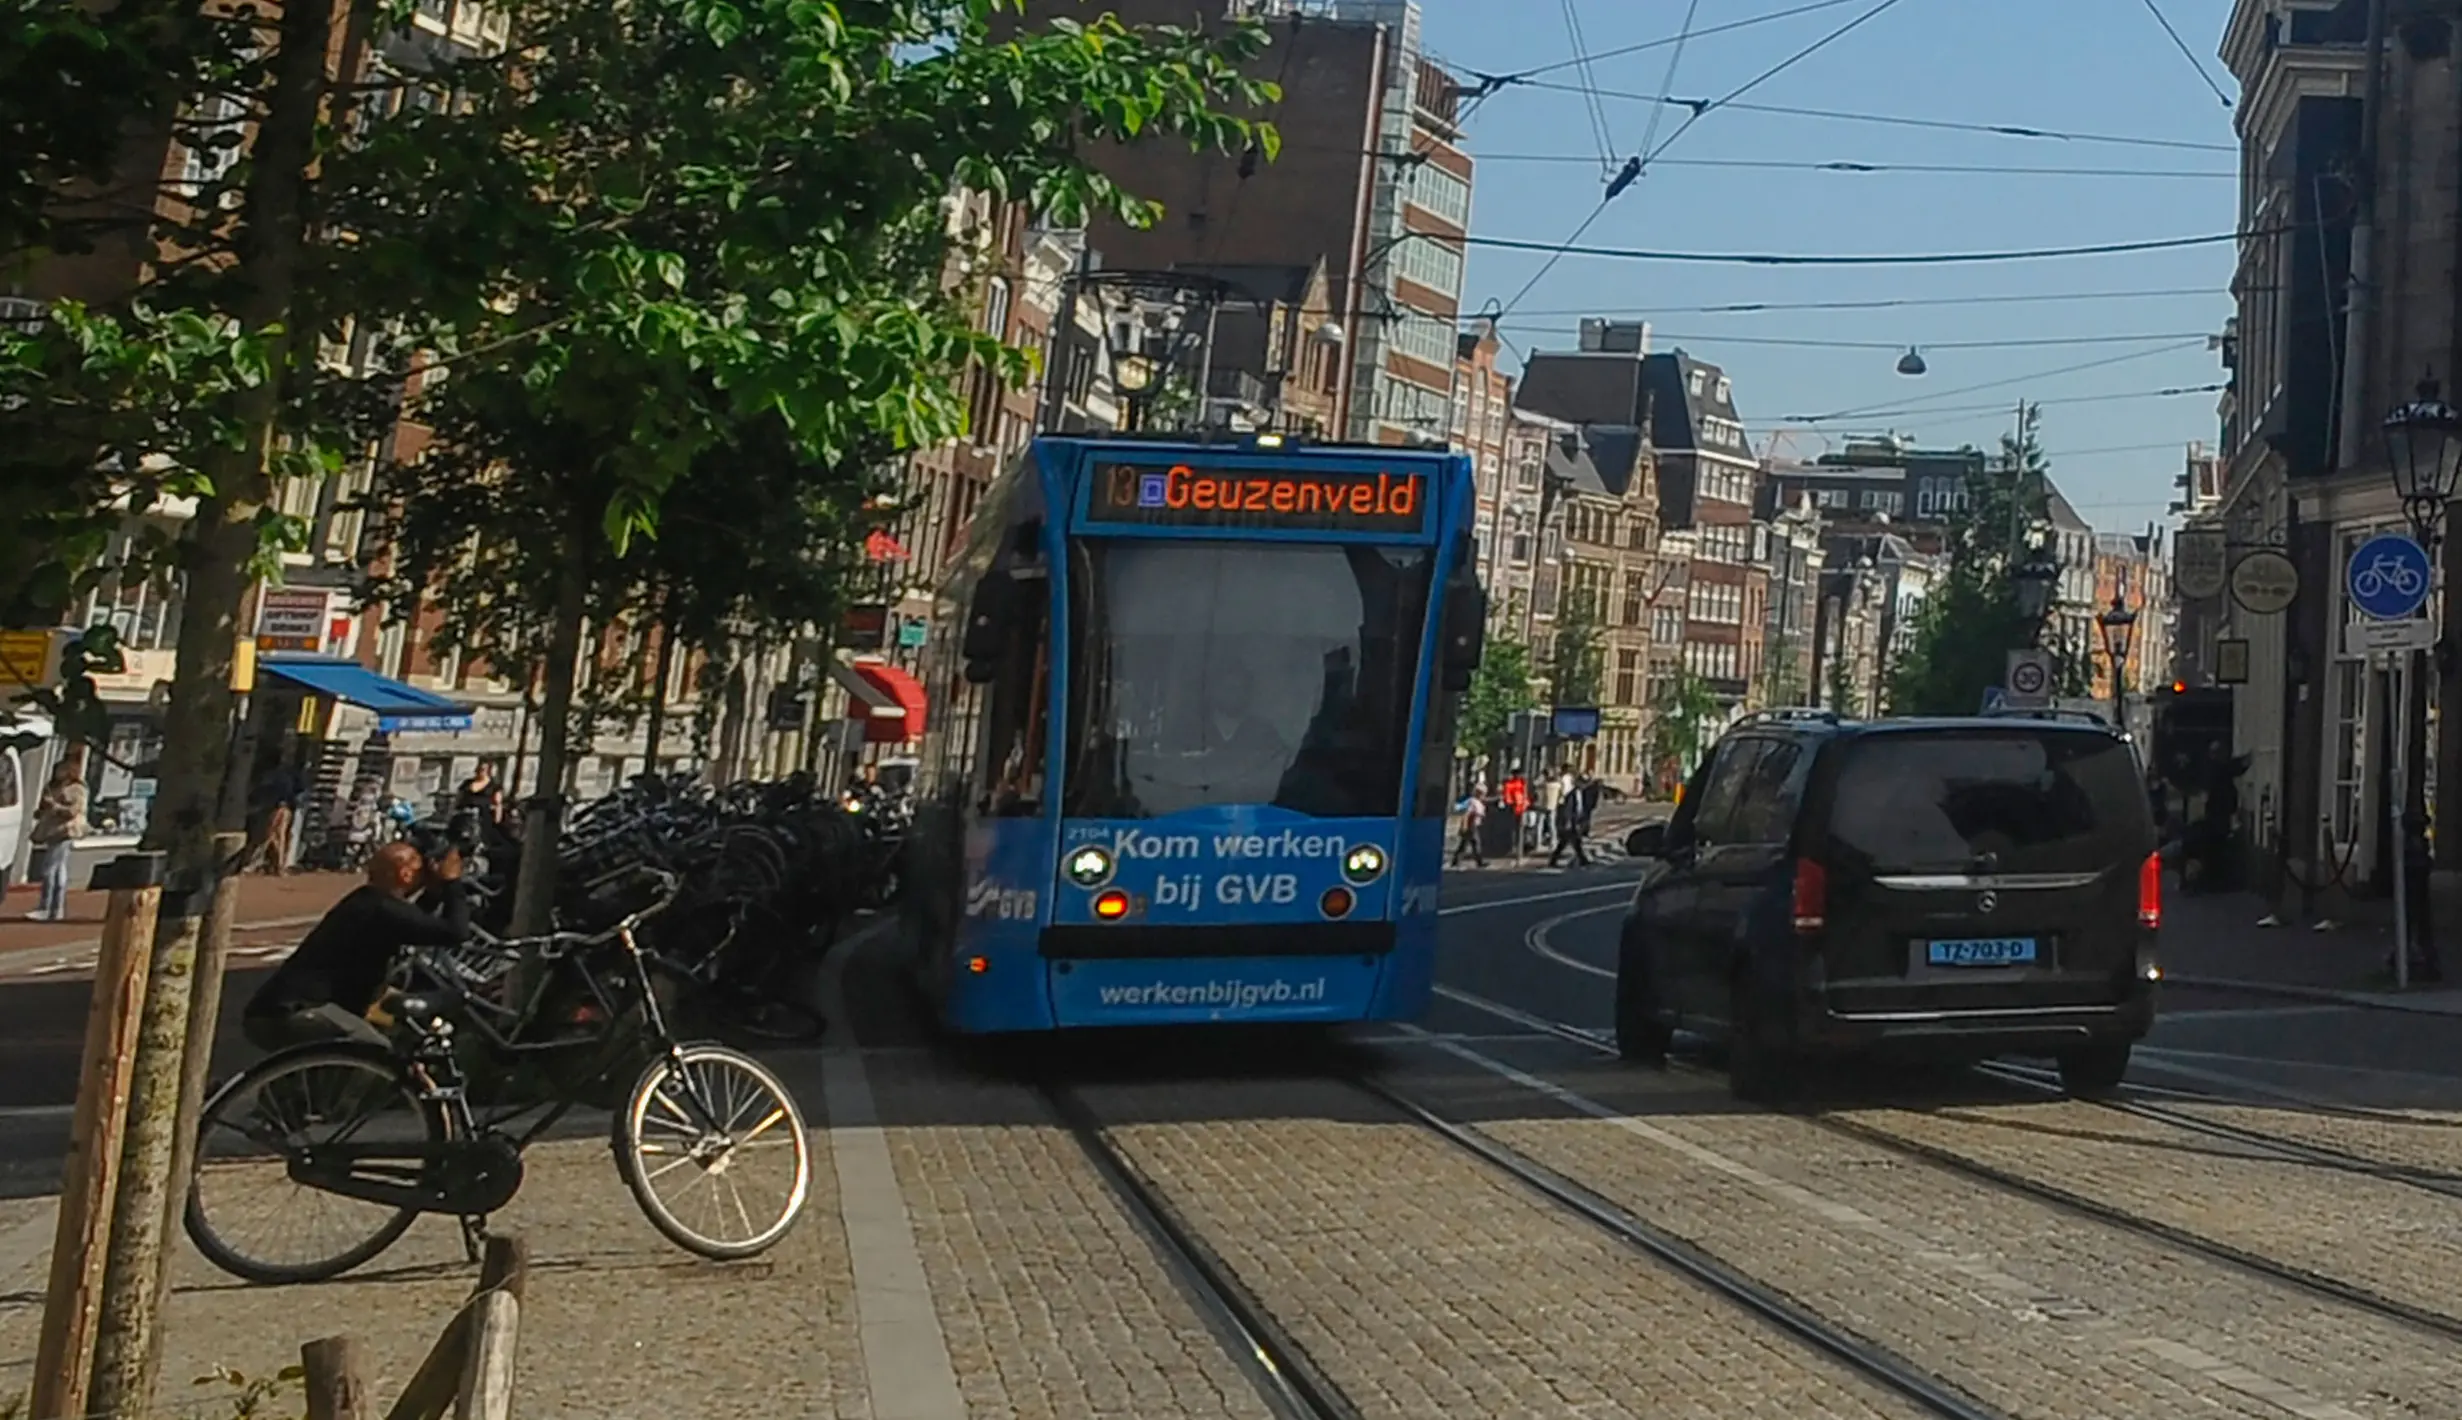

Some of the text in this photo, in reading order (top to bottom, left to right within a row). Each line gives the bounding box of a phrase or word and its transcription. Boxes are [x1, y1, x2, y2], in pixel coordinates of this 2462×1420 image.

[1105, 465, 1418, 516] 13 Geuzenveld
[1113, 828, 1346, 860] Kom werken
[1154, 873, 1298, 912] bij GVB
[1100, 978, 1325, 1009] werkenbijgvb.nl
